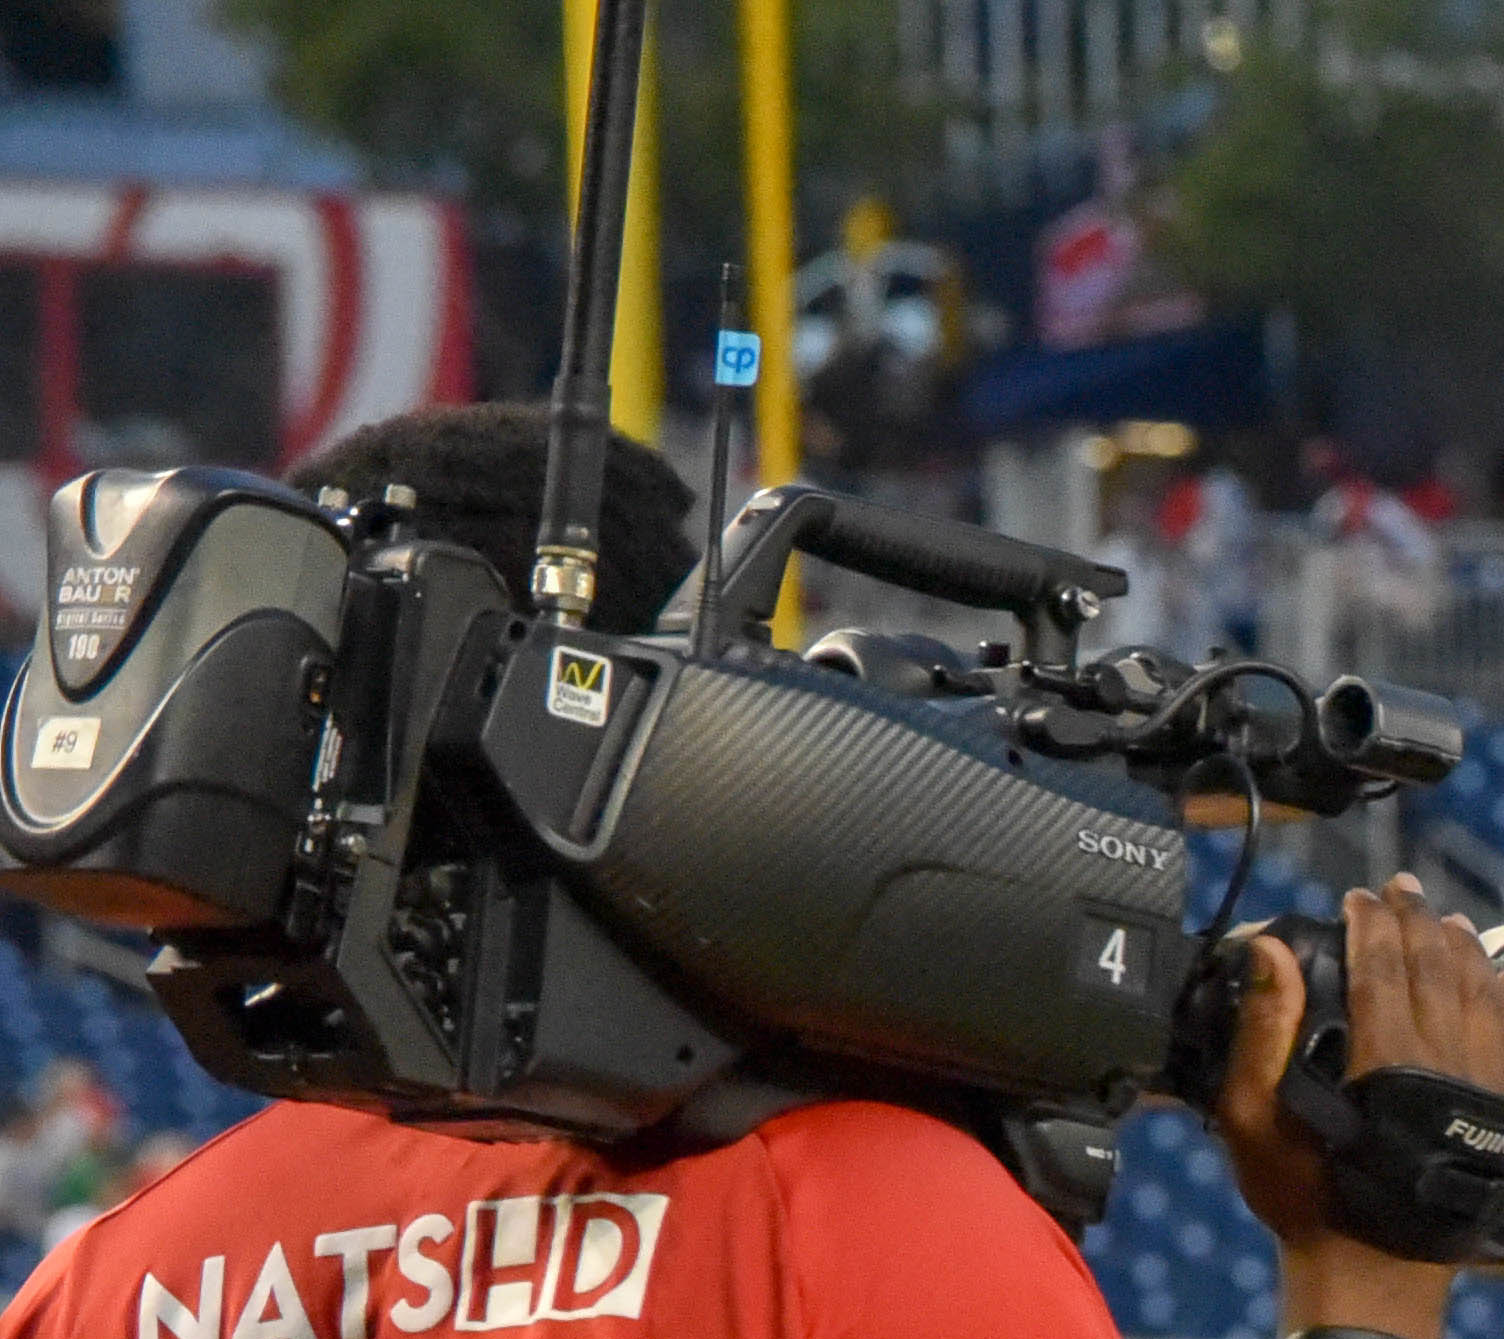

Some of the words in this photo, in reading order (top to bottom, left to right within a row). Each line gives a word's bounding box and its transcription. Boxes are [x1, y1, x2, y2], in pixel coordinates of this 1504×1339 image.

[62, 567, 136, 585] ANTON
[52, 730, 78, 755] #9
[1078, 829, 1169, 871] SONY
[1098, 928, 1127, 985] 4
